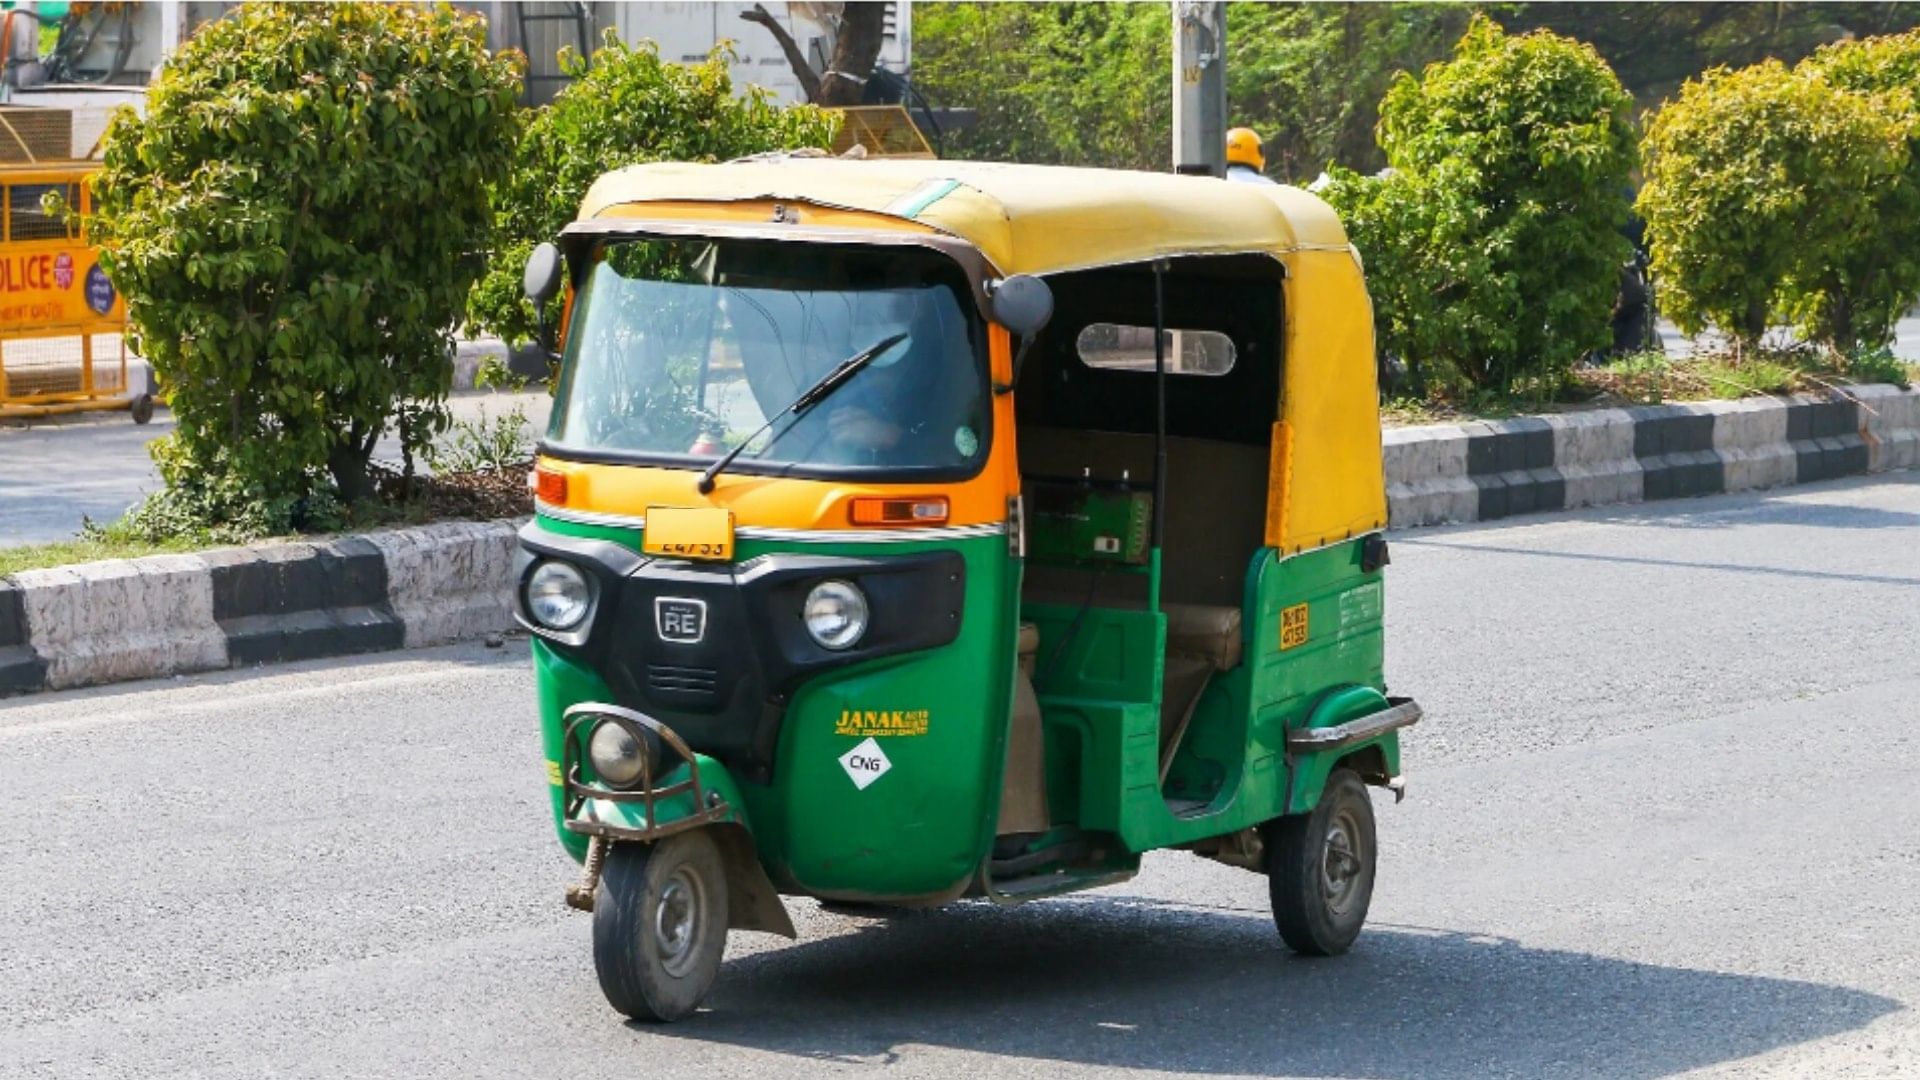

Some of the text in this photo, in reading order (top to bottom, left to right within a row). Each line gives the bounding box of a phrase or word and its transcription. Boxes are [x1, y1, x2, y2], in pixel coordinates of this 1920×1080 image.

[665, 612, 696, 634] RE
[836, 710, 905, 729] JANAK
[849, 755, 881, 772] CNG
